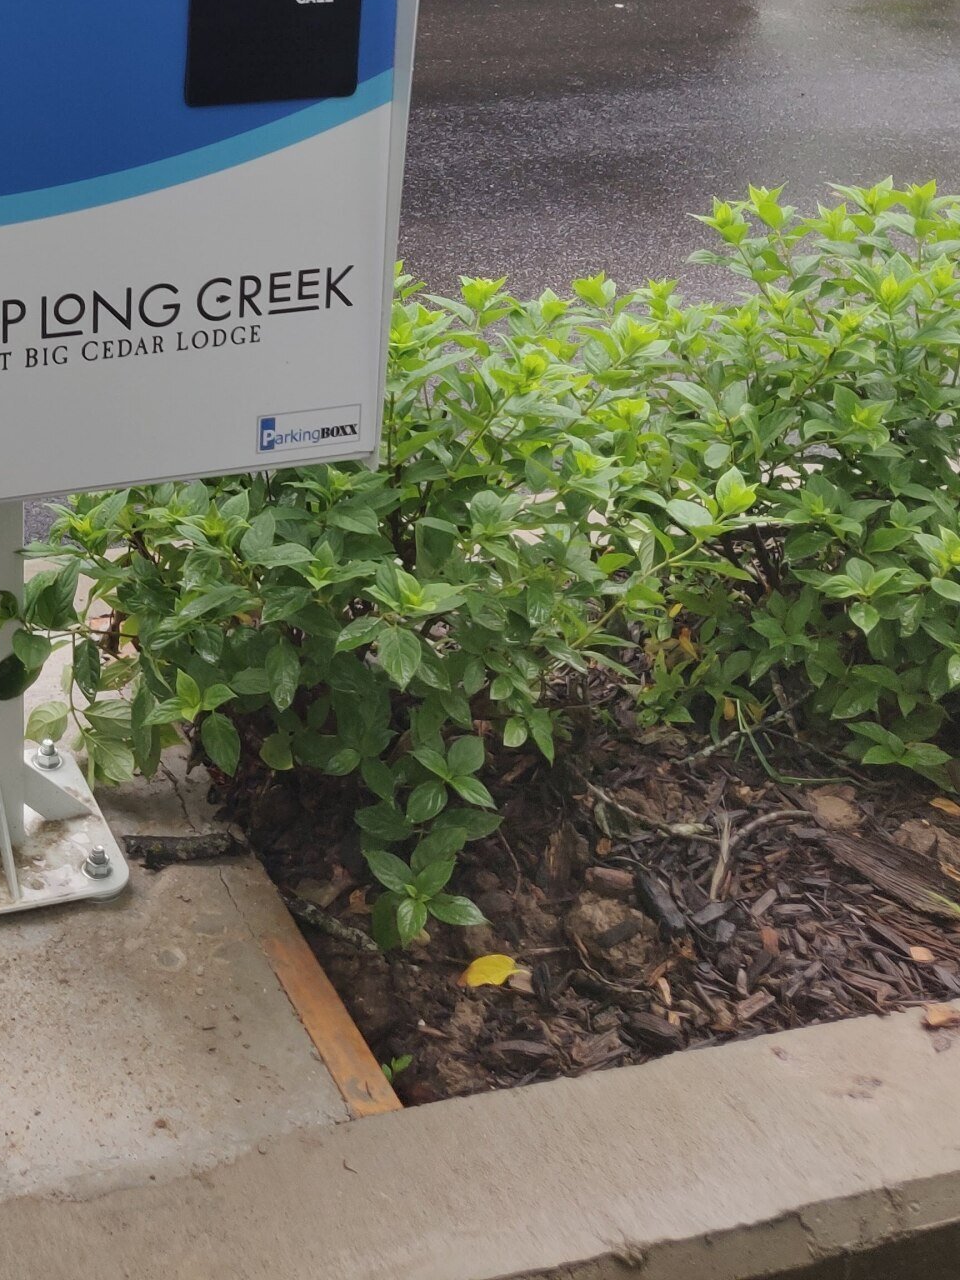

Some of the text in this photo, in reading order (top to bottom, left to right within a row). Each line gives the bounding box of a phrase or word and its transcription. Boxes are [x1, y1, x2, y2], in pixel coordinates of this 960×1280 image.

[40, 282, 182, 341] LONG
[196, 264, 355, 322] CREEK
[24, 345, 69, 369] BIG
[81, 335, 165, 362] CEDAR
[176, 324, 262, 352] LODGE
[261, 424, 358, 447] ParkingBOXX
